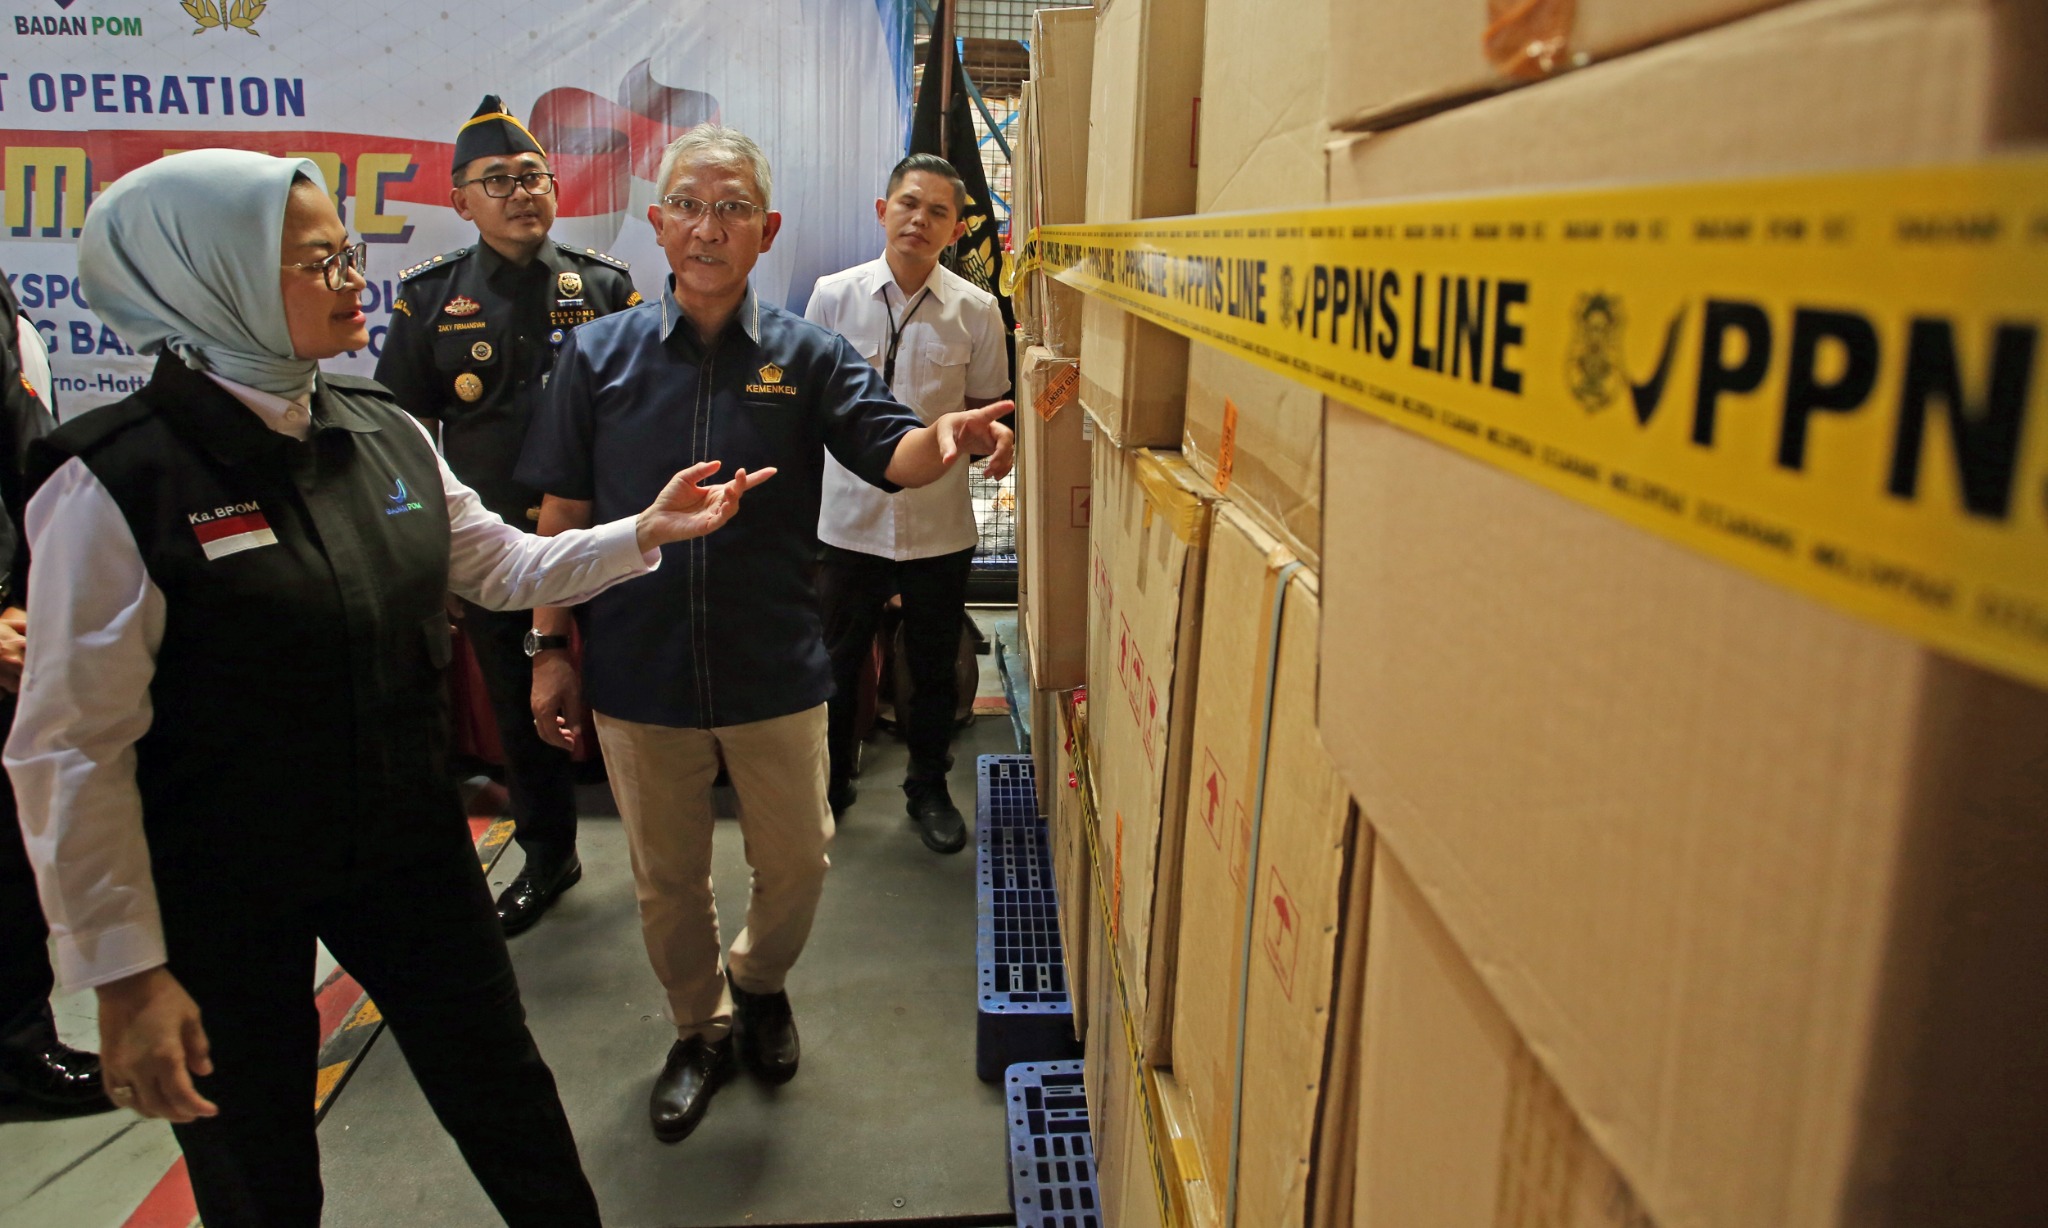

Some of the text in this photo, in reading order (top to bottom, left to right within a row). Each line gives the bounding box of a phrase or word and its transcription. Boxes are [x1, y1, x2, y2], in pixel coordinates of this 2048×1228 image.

[16, 16, 143, 37] BADAN POM
[29, 72, 306, 117] OPERATION
[1187, 255, 1224, 313] PPNS
[1228, 258, 1267, 324] LINE
[550, 310, 595, 318] CUSTOMS
[1313, 264, 1402, 361] PPNS
[1412, 272, 1529, 395] LINE
[746, 384, 797, 395] KEMENKEU
[1047, 384, 1066, 406] AGENT
[188, 500, 260, 525] Ka. BPOM
